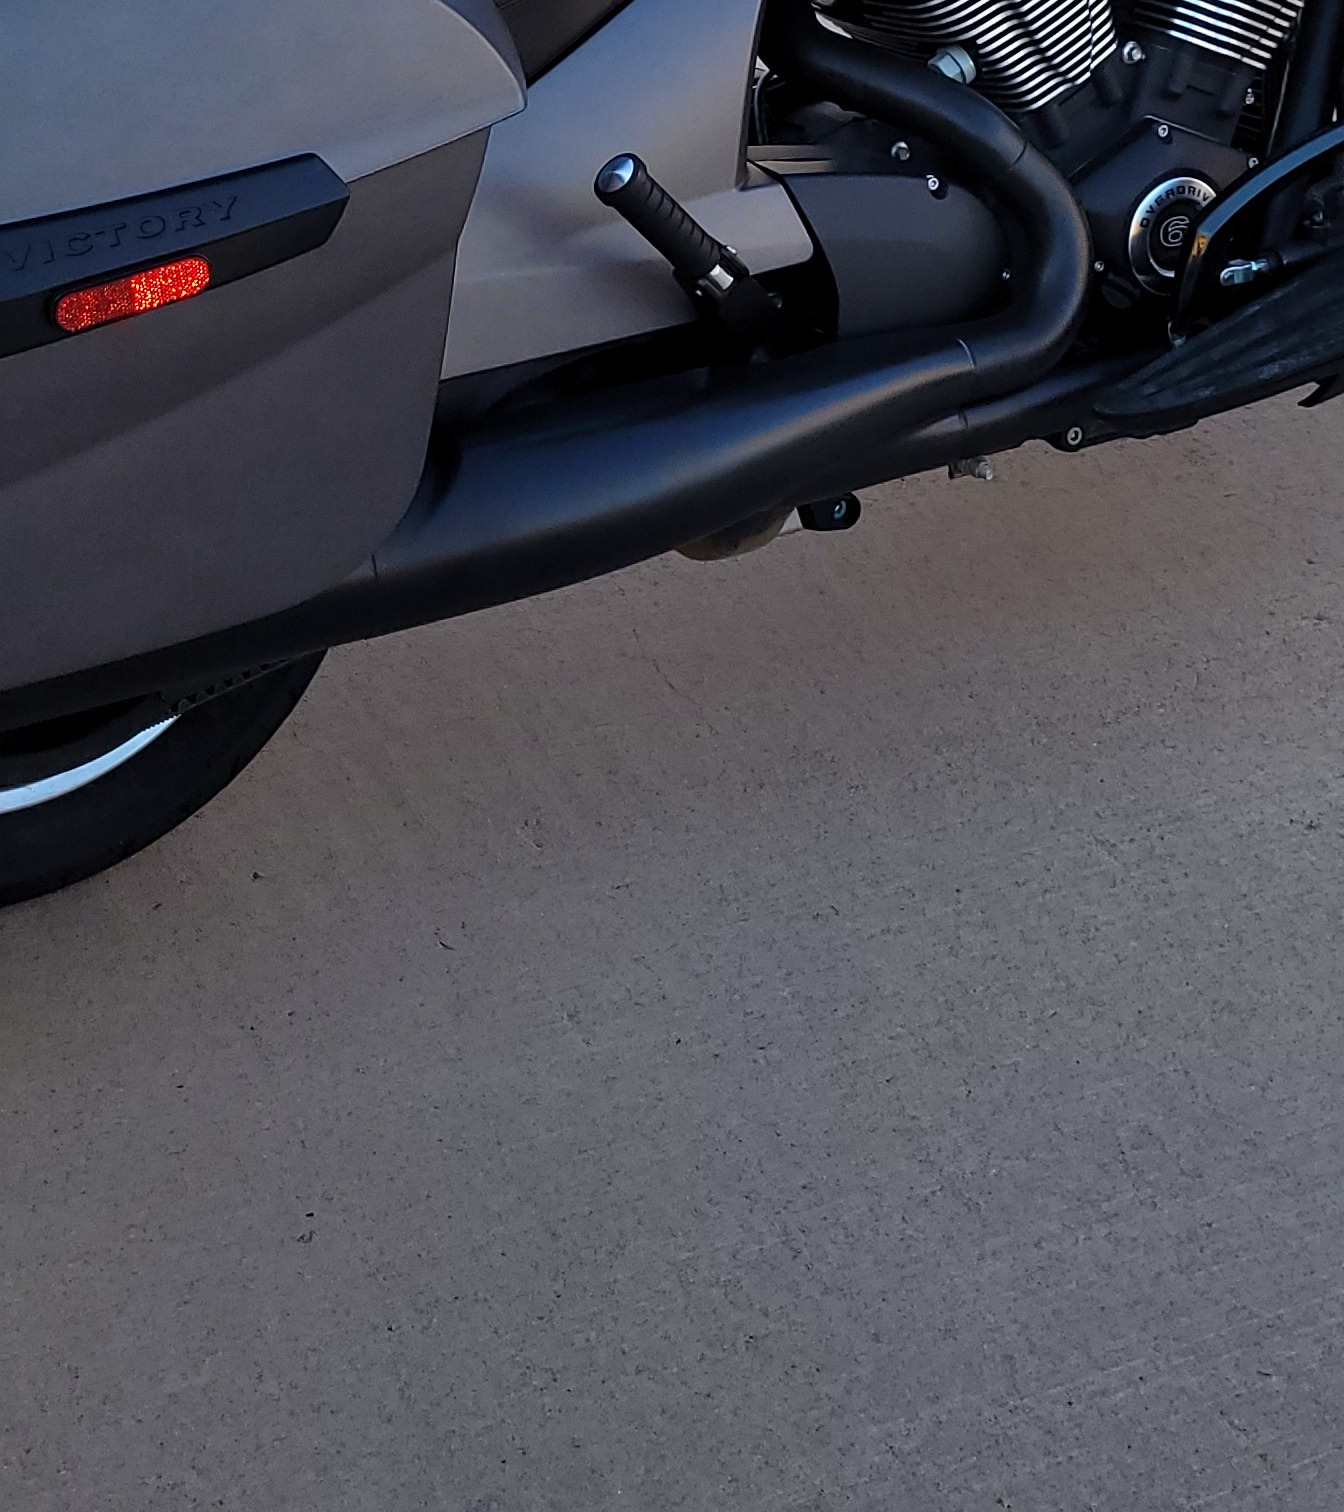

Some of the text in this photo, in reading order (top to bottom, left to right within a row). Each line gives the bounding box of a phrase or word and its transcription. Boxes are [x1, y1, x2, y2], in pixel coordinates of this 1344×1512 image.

[1140, 185, 1211, 228] OVERDRIV
[3, 196, 237, 271] VICTORY
[1160, 216, 1190, 247] 6
